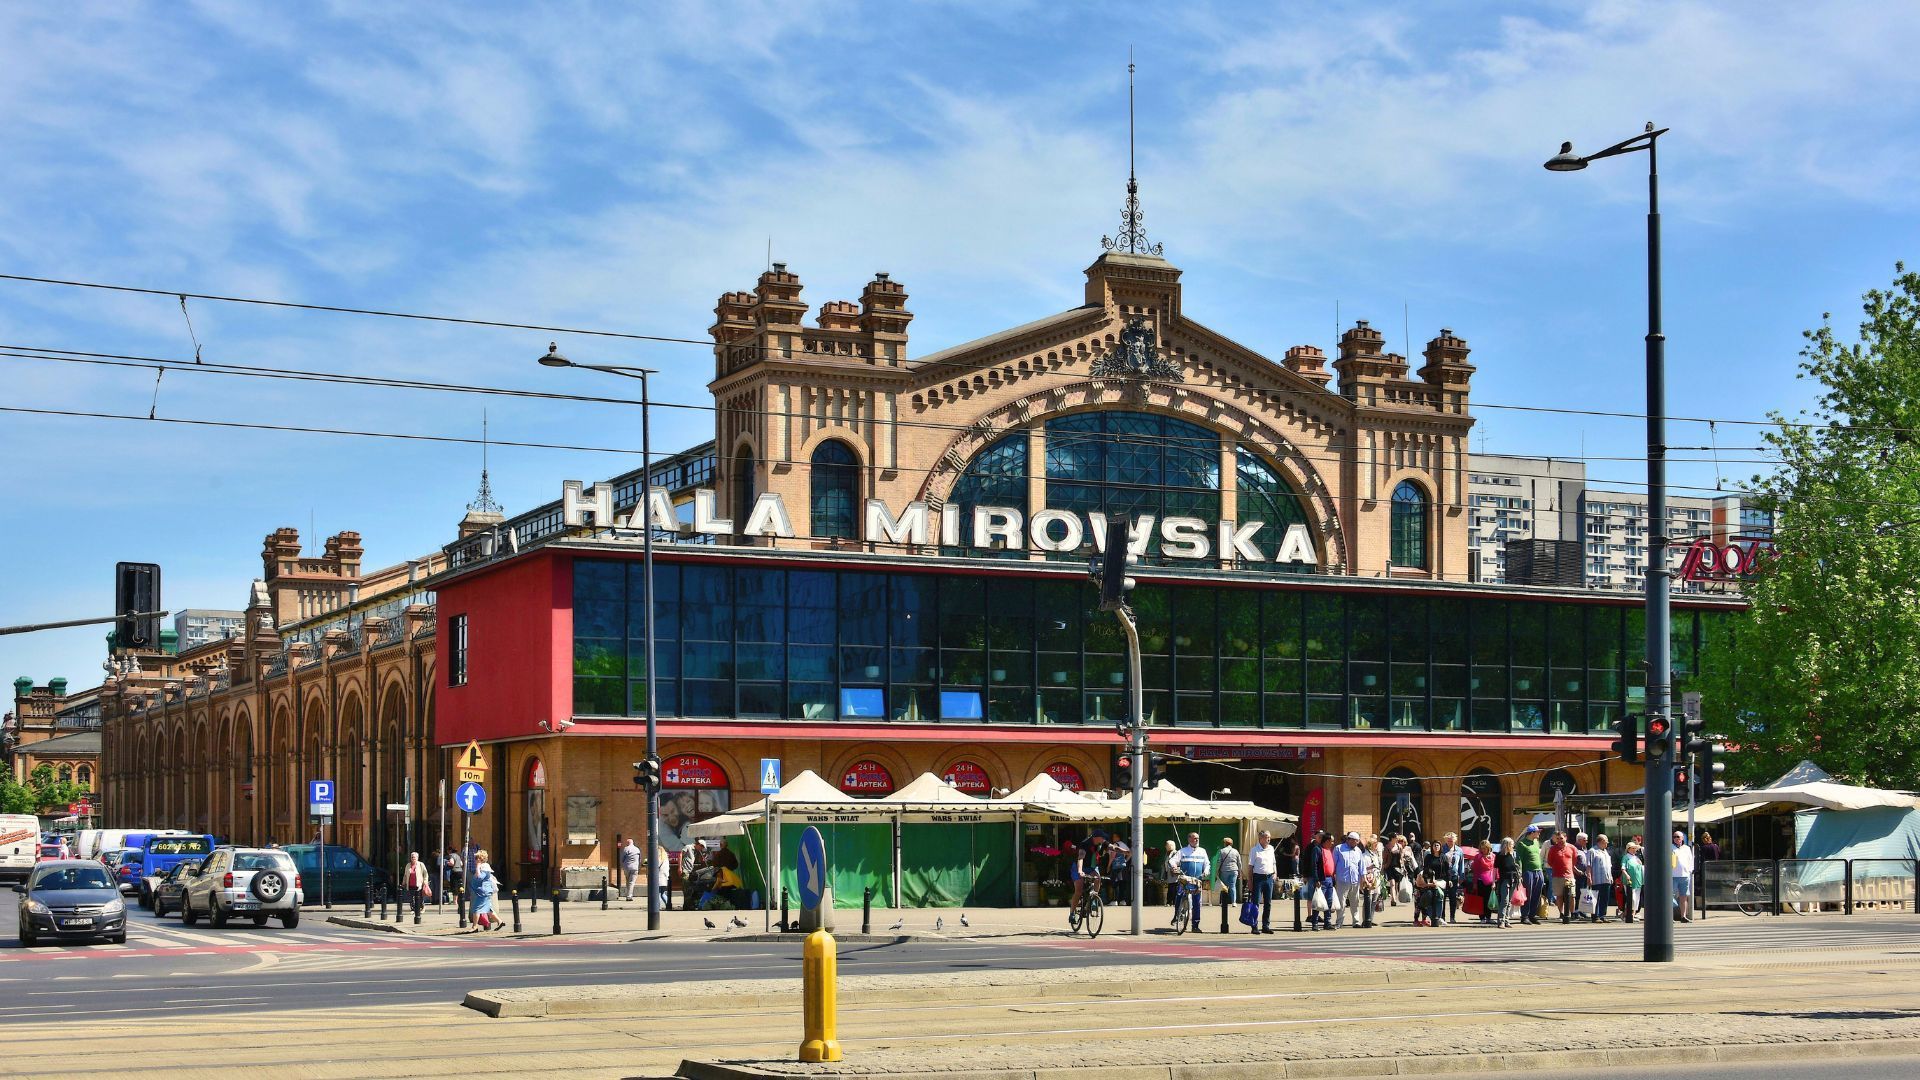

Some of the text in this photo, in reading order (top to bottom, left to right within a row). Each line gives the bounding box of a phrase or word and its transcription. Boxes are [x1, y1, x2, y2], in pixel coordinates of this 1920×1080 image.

[563, 480, 1318, 564] HALA MIROWSKA
[463, 772, 473, 780] 10
[315, 783, 329, 801] P
